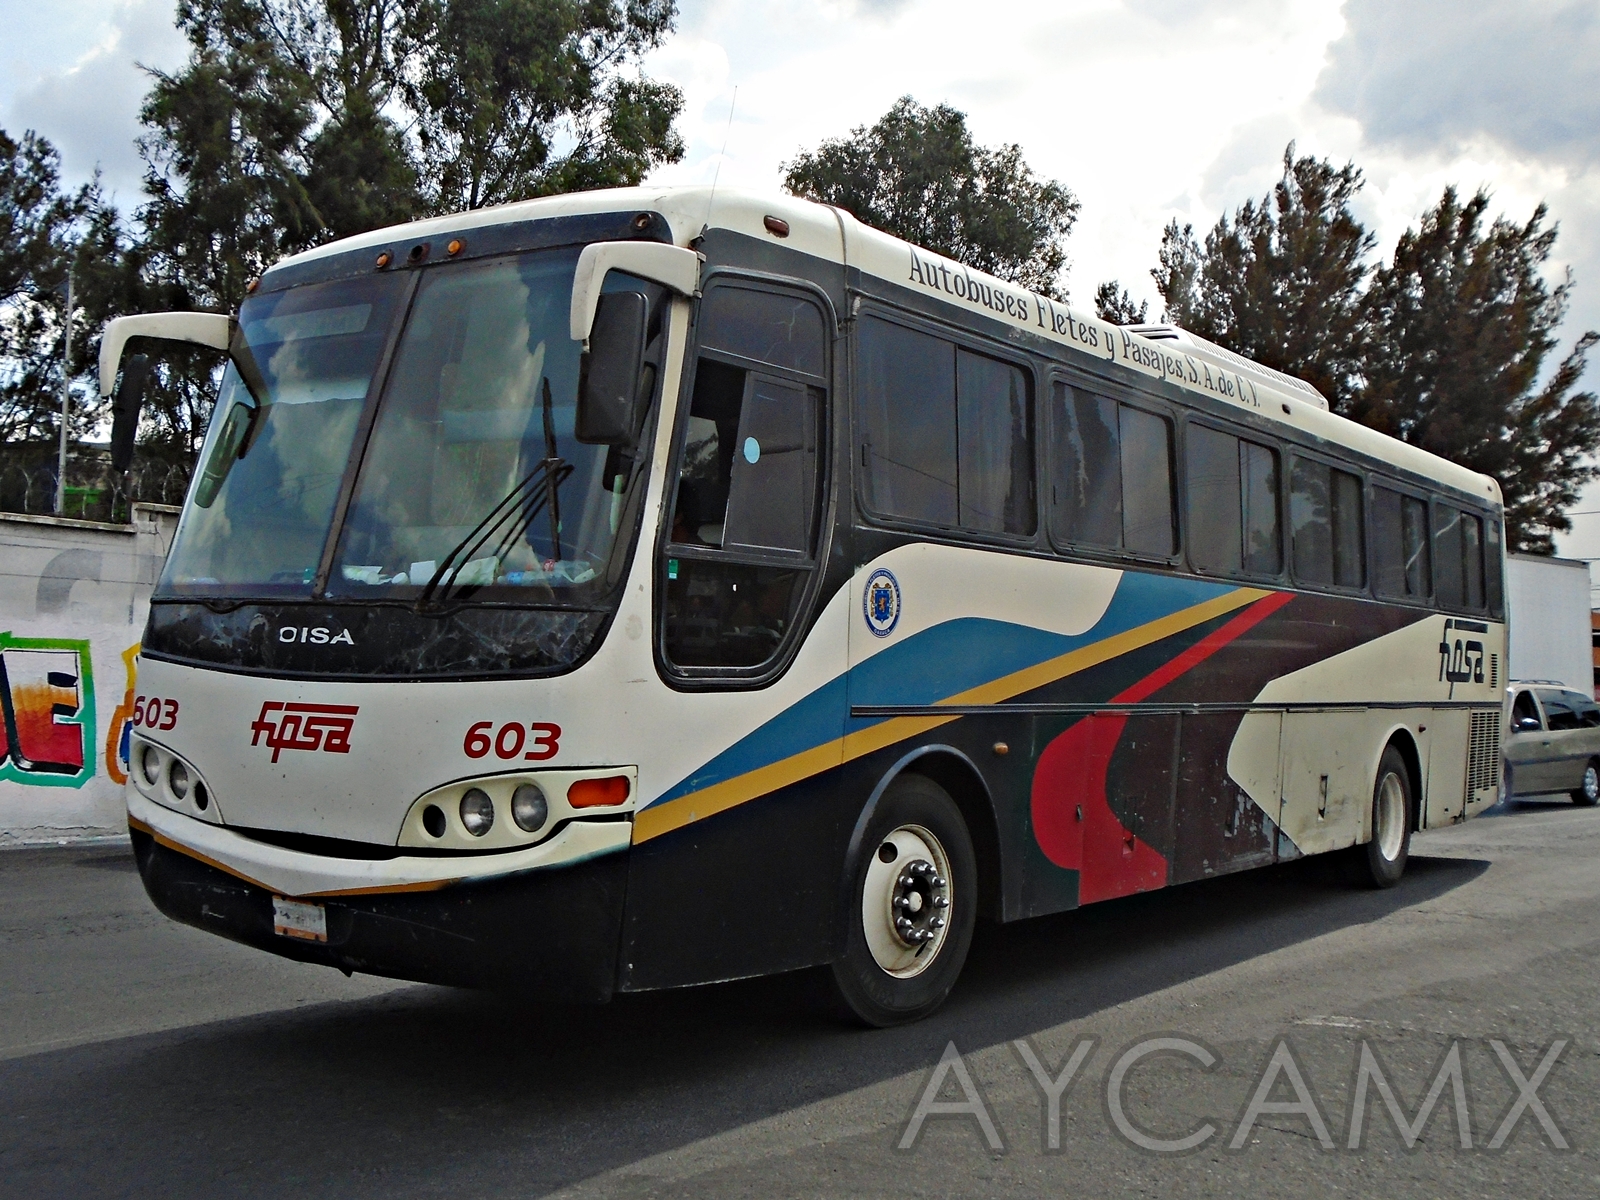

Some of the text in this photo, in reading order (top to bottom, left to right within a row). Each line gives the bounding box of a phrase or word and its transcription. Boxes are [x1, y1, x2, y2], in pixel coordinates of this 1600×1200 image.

[907, 244, 1029, 322] Autobuses
[1033, 293, 1099, 348] Fletes
[1104, 331, 1115, 361] y
[132, 695, 179, 731] 603
[463, 721, 562, 761] 603
